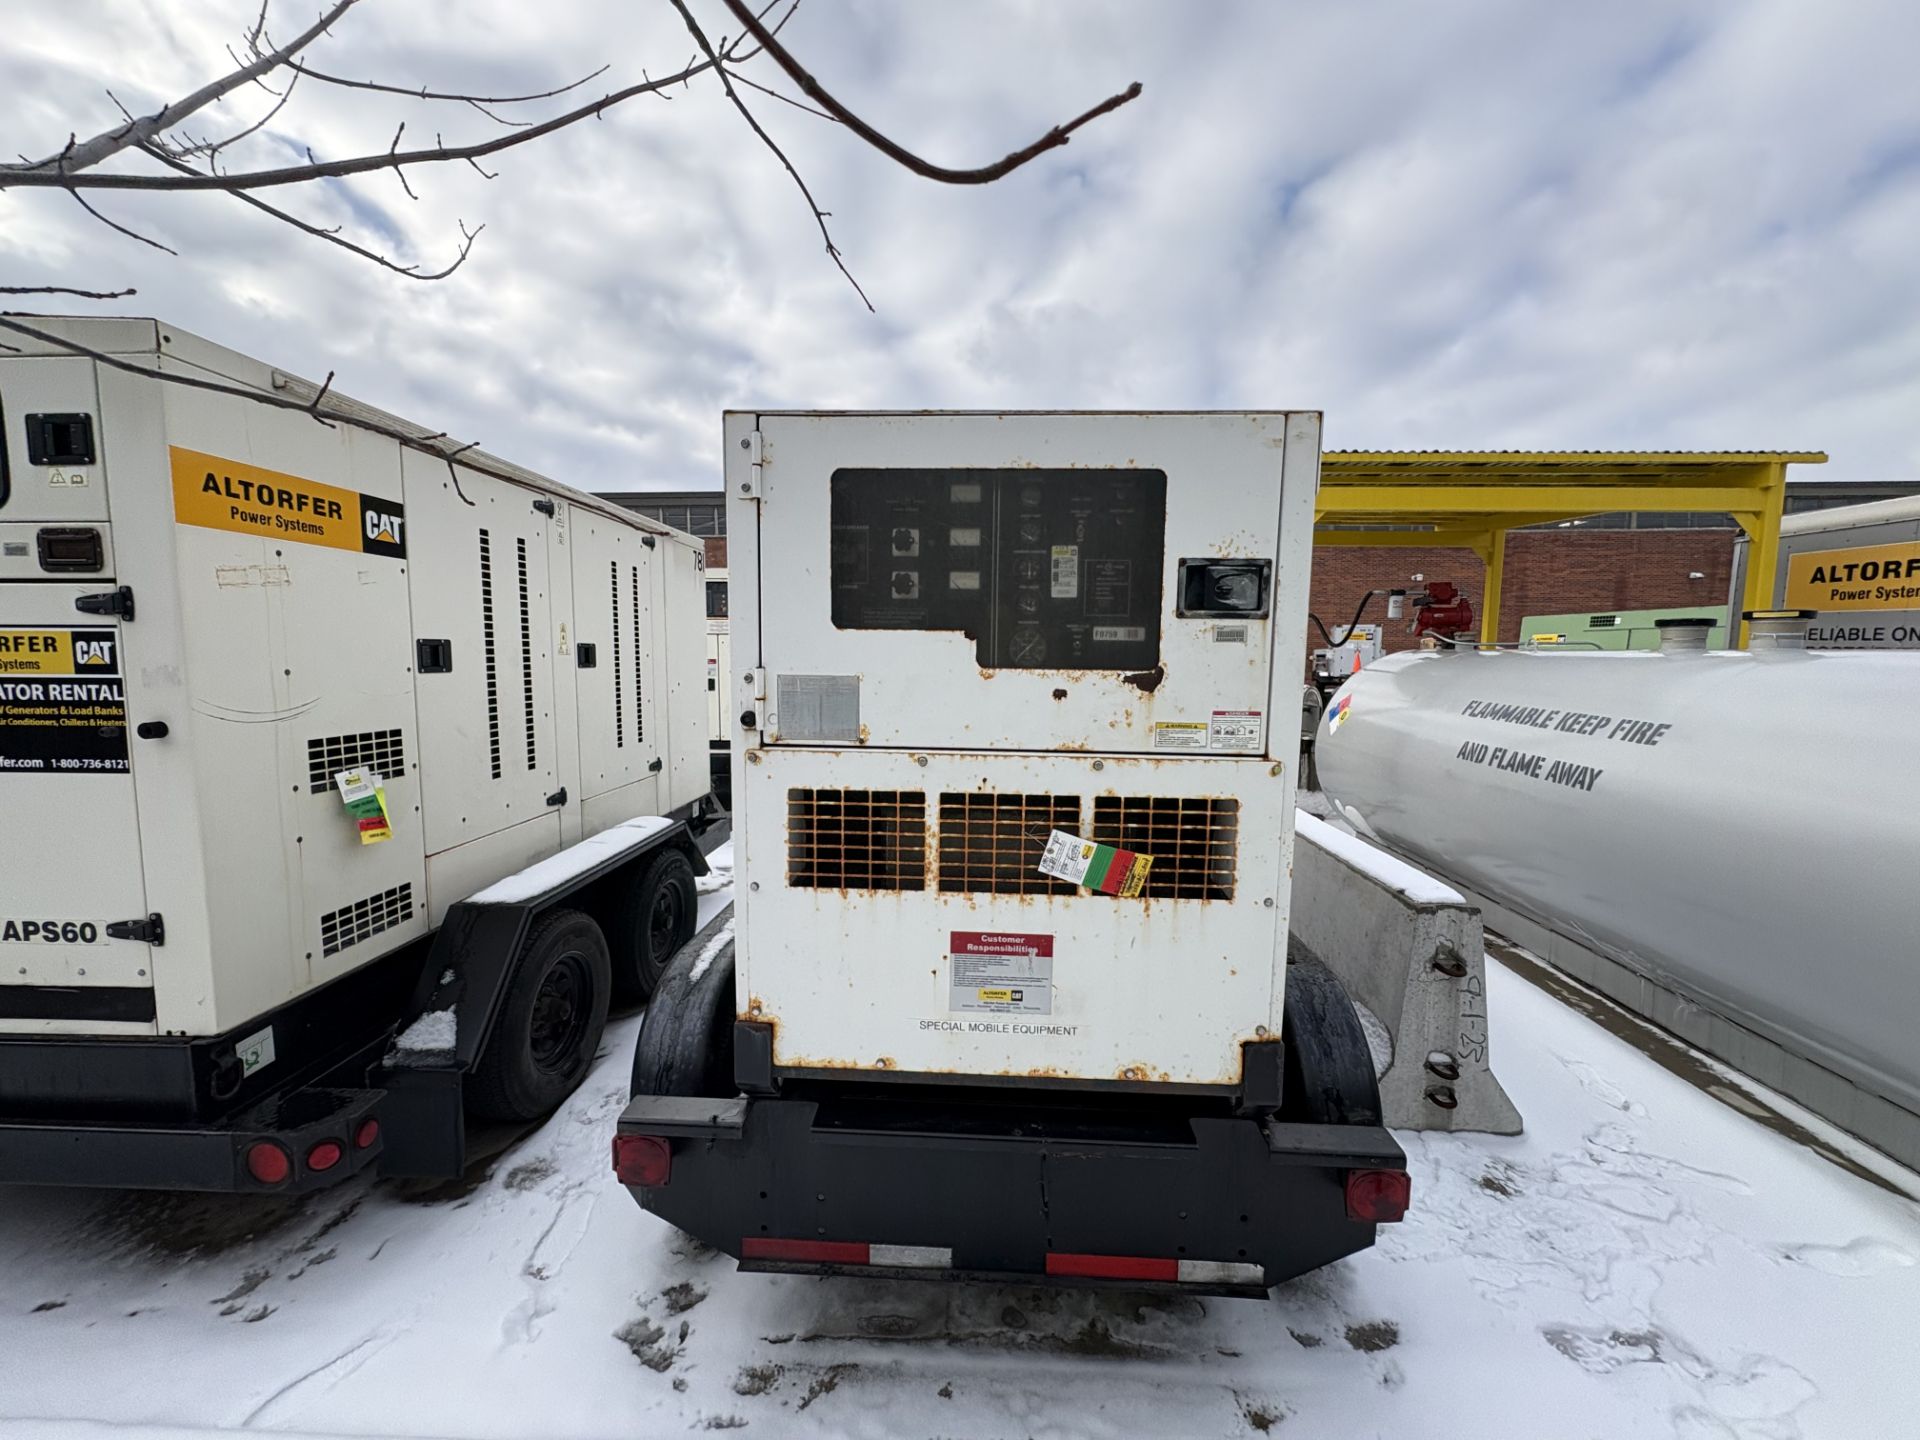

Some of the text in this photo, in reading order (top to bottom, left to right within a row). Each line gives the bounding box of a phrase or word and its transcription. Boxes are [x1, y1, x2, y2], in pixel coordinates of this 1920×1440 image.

[202, 472, 343, 520] ALTORFER
[230, 506, 325, 536] Power Systems
[365, 510, 402, 544] CAT
[1809, 558, 1920, 584] ALTORF
[1831, 588, 1872, 601] Power
[1803, 627, 1885, 641] ELIABLE
[75, 641, 113, 665] CAT
[48, 684, 125, 701] RENTAL
[5, 706, 58, 715] Generators
[60, 706, 68, 715] &
[69, 706, 92, 715] Load
[94, 706, 124, 715] Banks
[8, 718, 59, 727] Conditioners,
[60, 718, 88, 726] Chillers
[1461, 700, 1672, 746] FLAMMABLE KEEP FIRE
[51, 759, 129, 769] 1-800-736-8121
[1456, 741, 1603, 791] AND FLAME AWAY
[2, 920, 97, 943] APS60
[981, 934, 1025, 944] Customer
[919, 1020, 1078, 1036] SPECIAL MOBILE EQUIPMENT
